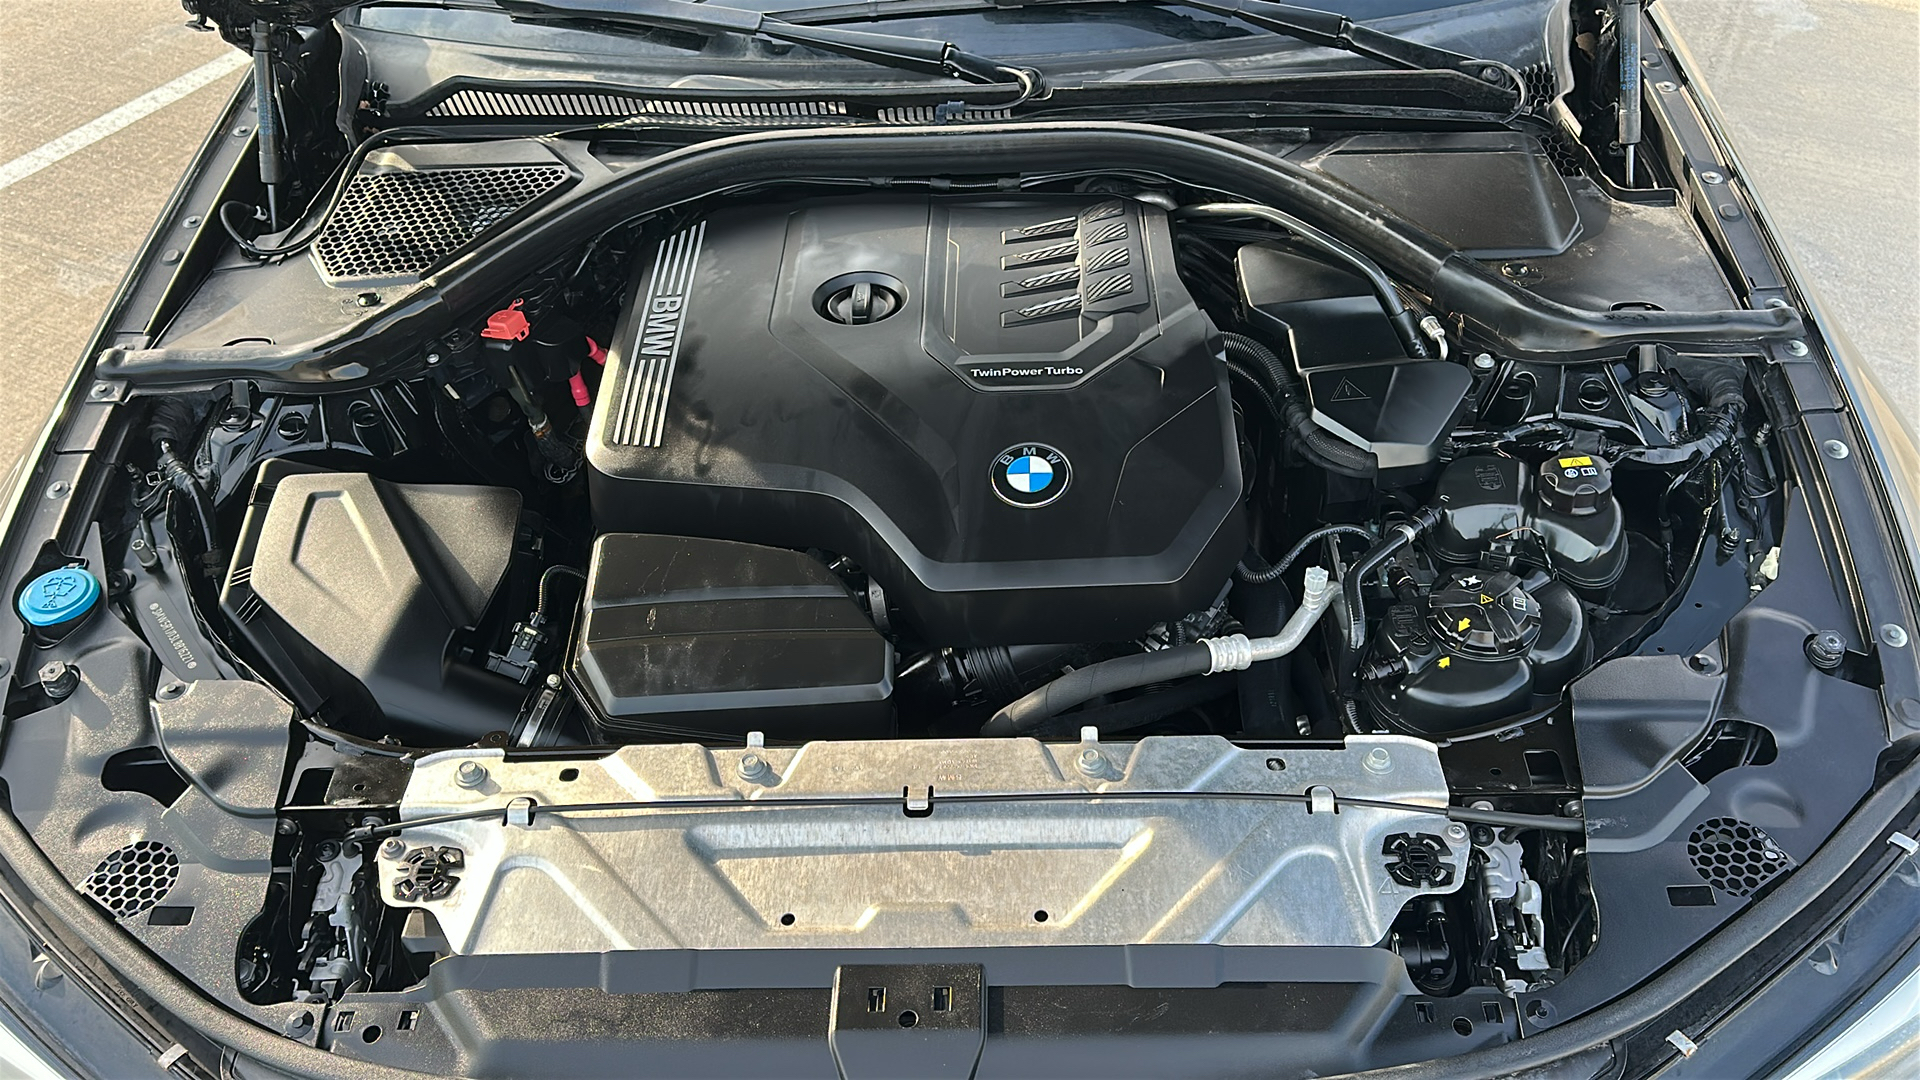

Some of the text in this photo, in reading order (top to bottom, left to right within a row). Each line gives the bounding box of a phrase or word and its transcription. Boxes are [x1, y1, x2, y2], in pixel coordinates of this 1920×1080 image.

[640, 296, 682, 356] BMW
[970, 366, 1084, 377] TwinPower Turbo
[1000, 447, 1061, 466] BMW
